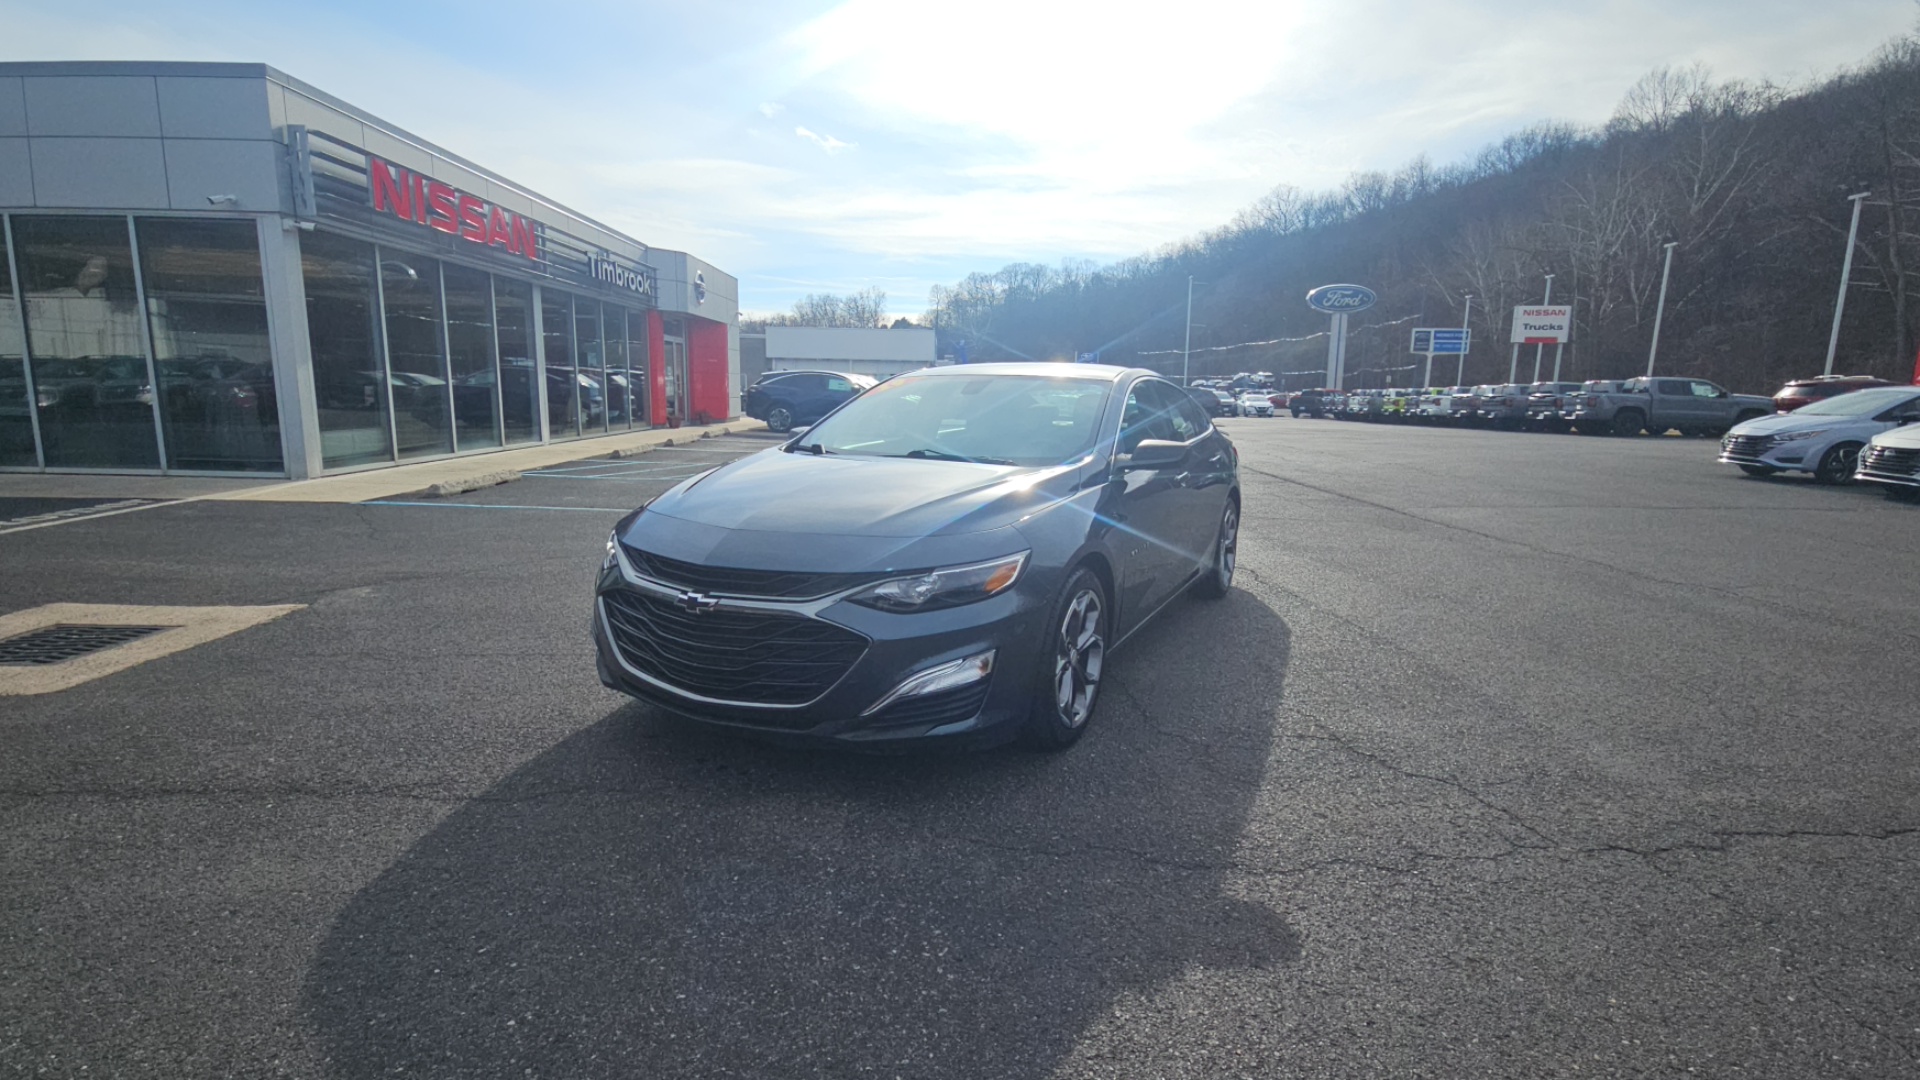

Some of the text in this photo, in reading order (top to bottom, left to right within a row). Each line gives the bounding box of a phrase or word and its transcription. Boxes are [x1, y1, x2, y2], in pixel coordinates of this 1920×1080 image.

[371, 156, 538, 260] NISSAN
[587, 252, 652, 296] Timbrook
[1323, 289, 1363, 307] Ford
[1523, 309, 1567, 317] NISSAN
[1523, 323, 1563, 331] Trucks
